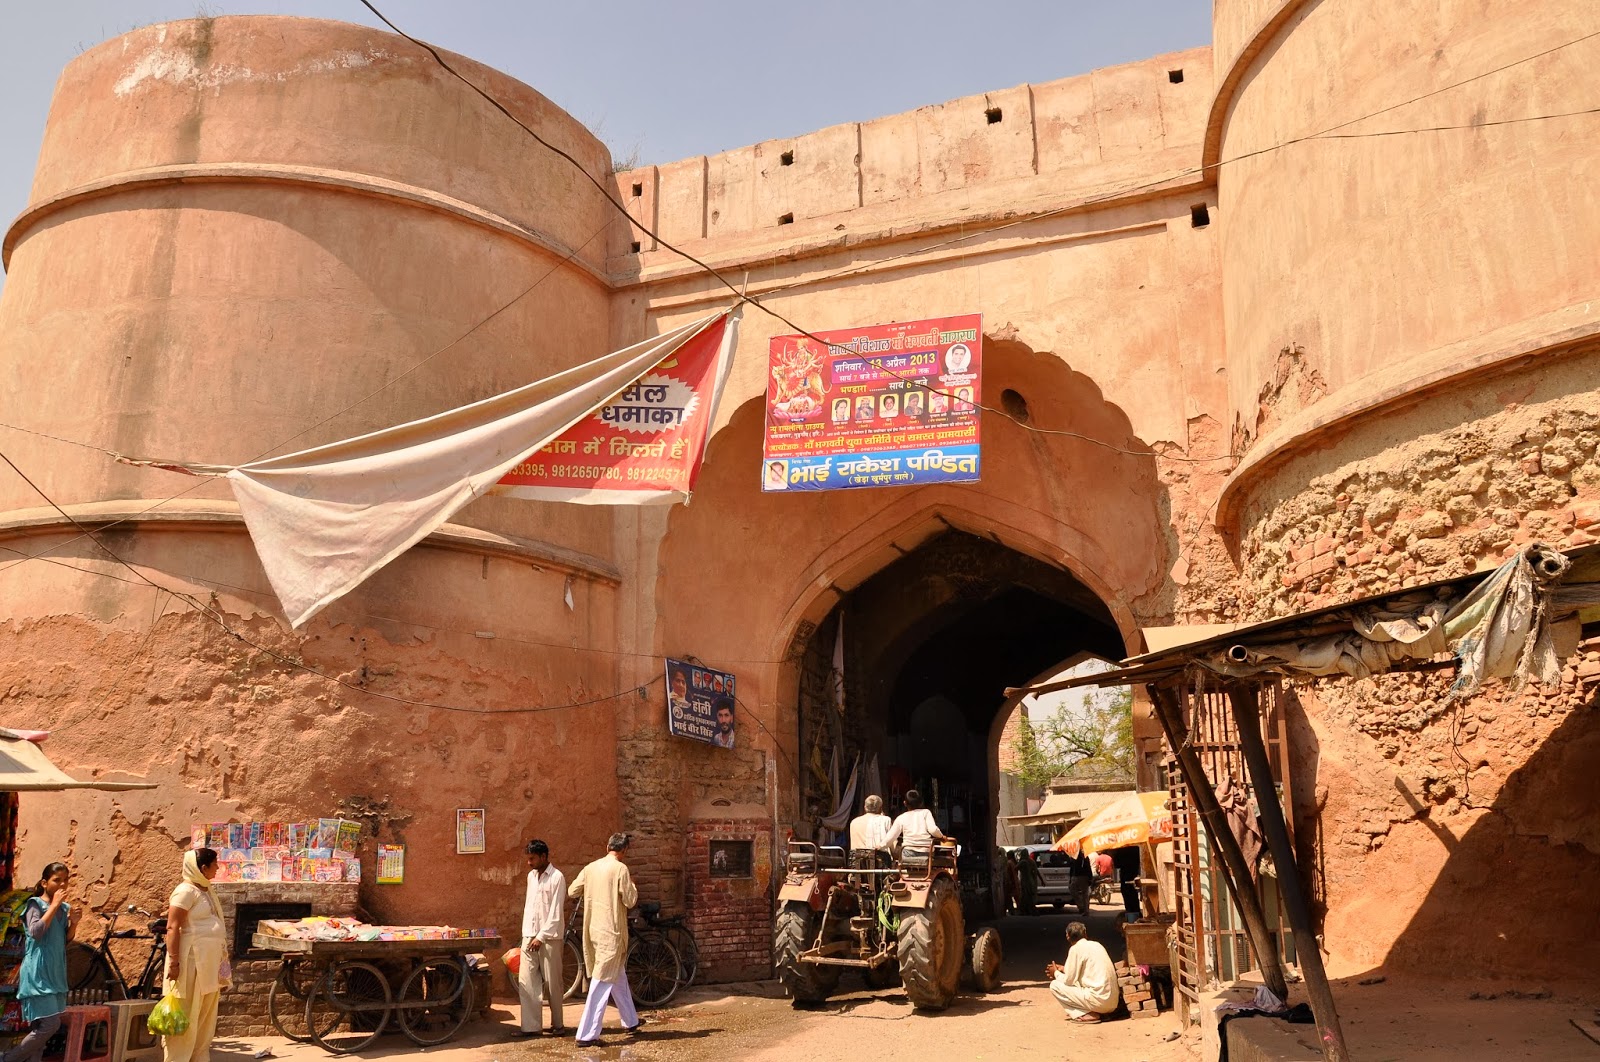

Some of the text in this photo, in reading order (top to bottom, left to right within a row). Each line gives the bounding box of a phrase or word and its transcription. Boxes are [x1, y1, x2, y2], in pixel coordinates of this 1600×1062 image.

[859, 336, 890, 353] विशाल
[940, 329, 977, 344] जागरण
[870, 359, 882, 369] 13
[886, 356, 906, 368] अप्रैल
[910, 353, 936, 366] 2013
[621, 379, 669, 403] सेल
[602, 406, 685, 424] धमाका
[583, 436, 606, 455] में
[609, 436, 667, 458] मिलते
[815, 436, 844, 448] भगवती
[551, 465, 623, 482] 9812650780,
[790, 449, 978, 484] भाई राकेश पण्डित
